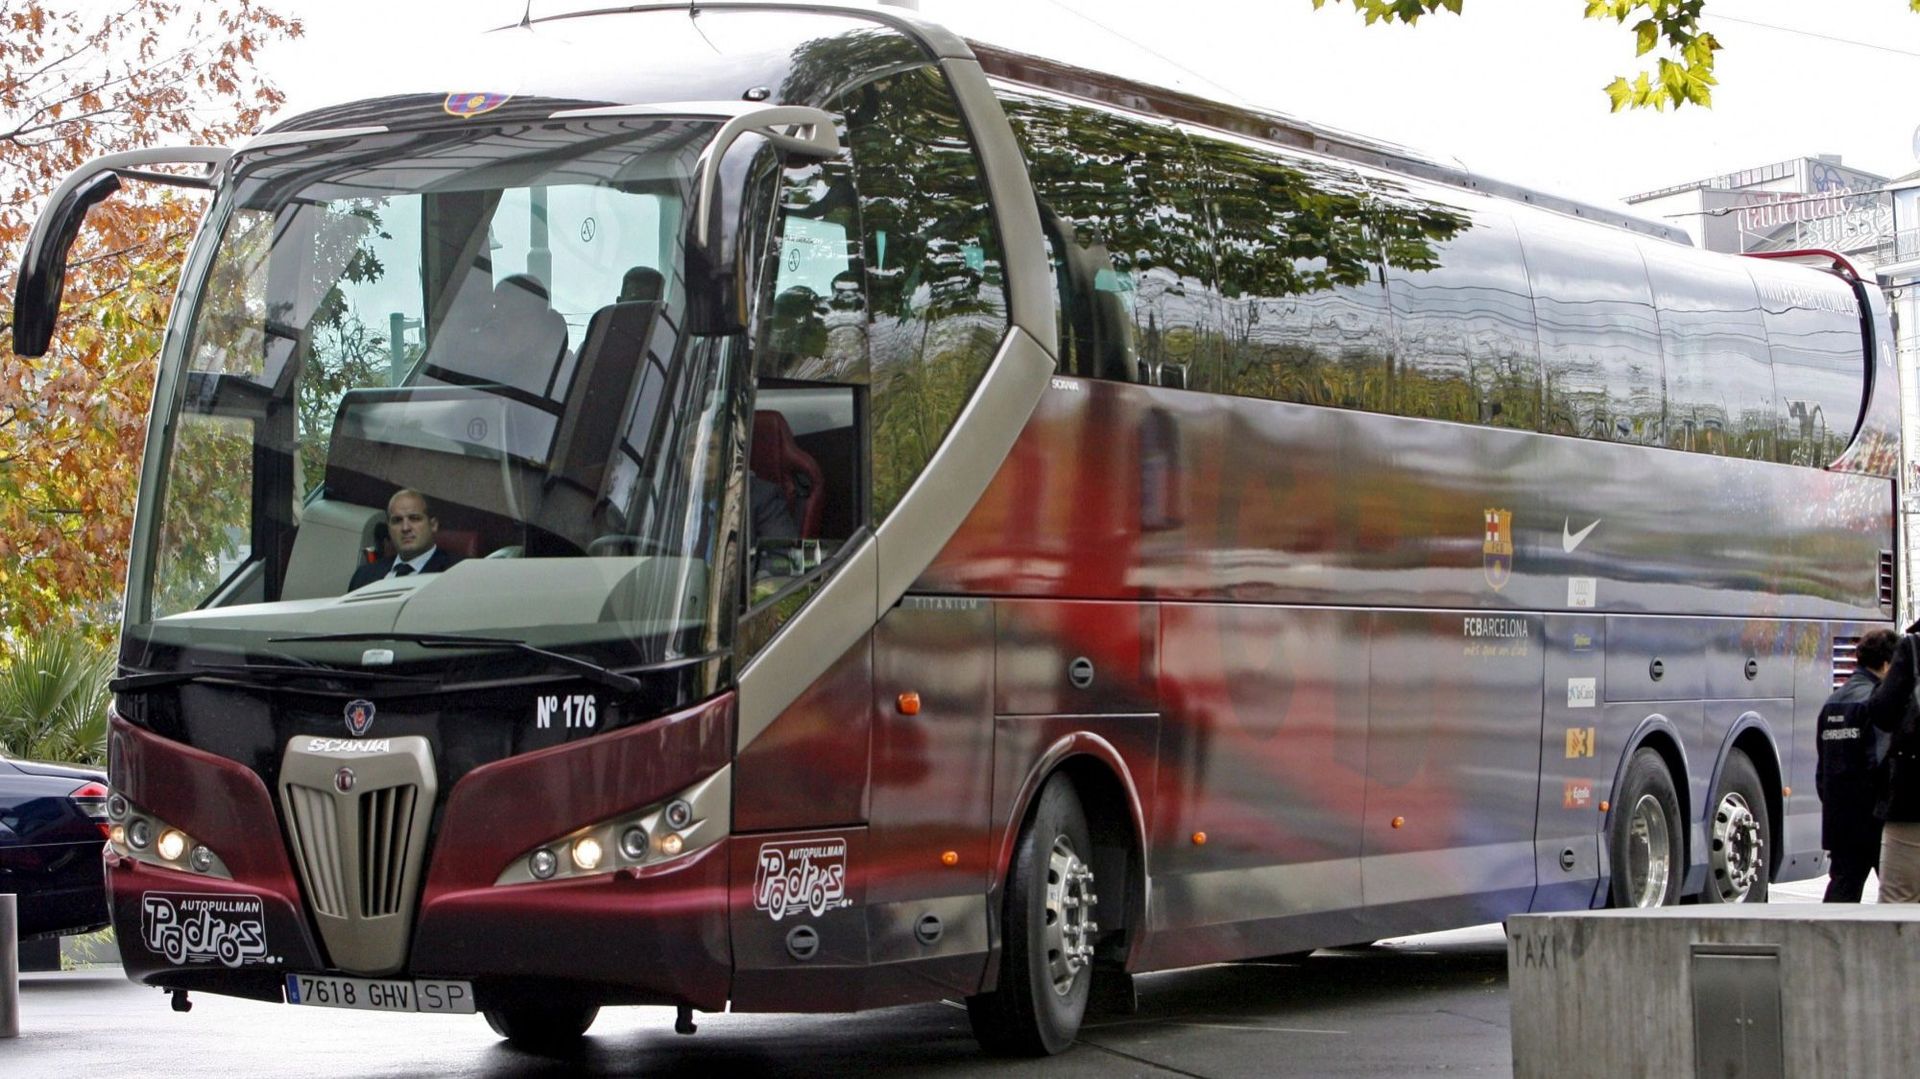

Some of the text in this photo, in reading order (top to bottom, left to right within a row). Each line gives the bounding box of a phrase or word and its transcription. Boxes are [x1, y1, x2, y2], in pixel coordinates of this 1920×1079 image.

[915, 598, 977, 609] TITANIUM
[1464, 617, 1528, 637] FCBARCELONA
[563, 694, 596, 728] 176
[308, 739, 389, 753] SCANIA
[787, 845, 844, 860] AUTOPULLMAN
[180, 900, 260, 913] AUTOPULLMAN
[1512, 933, 1557, 969] TAXI
[302, 979, 408, 1009] 7618 GHV
[424, 984, 464, 1009] SP
